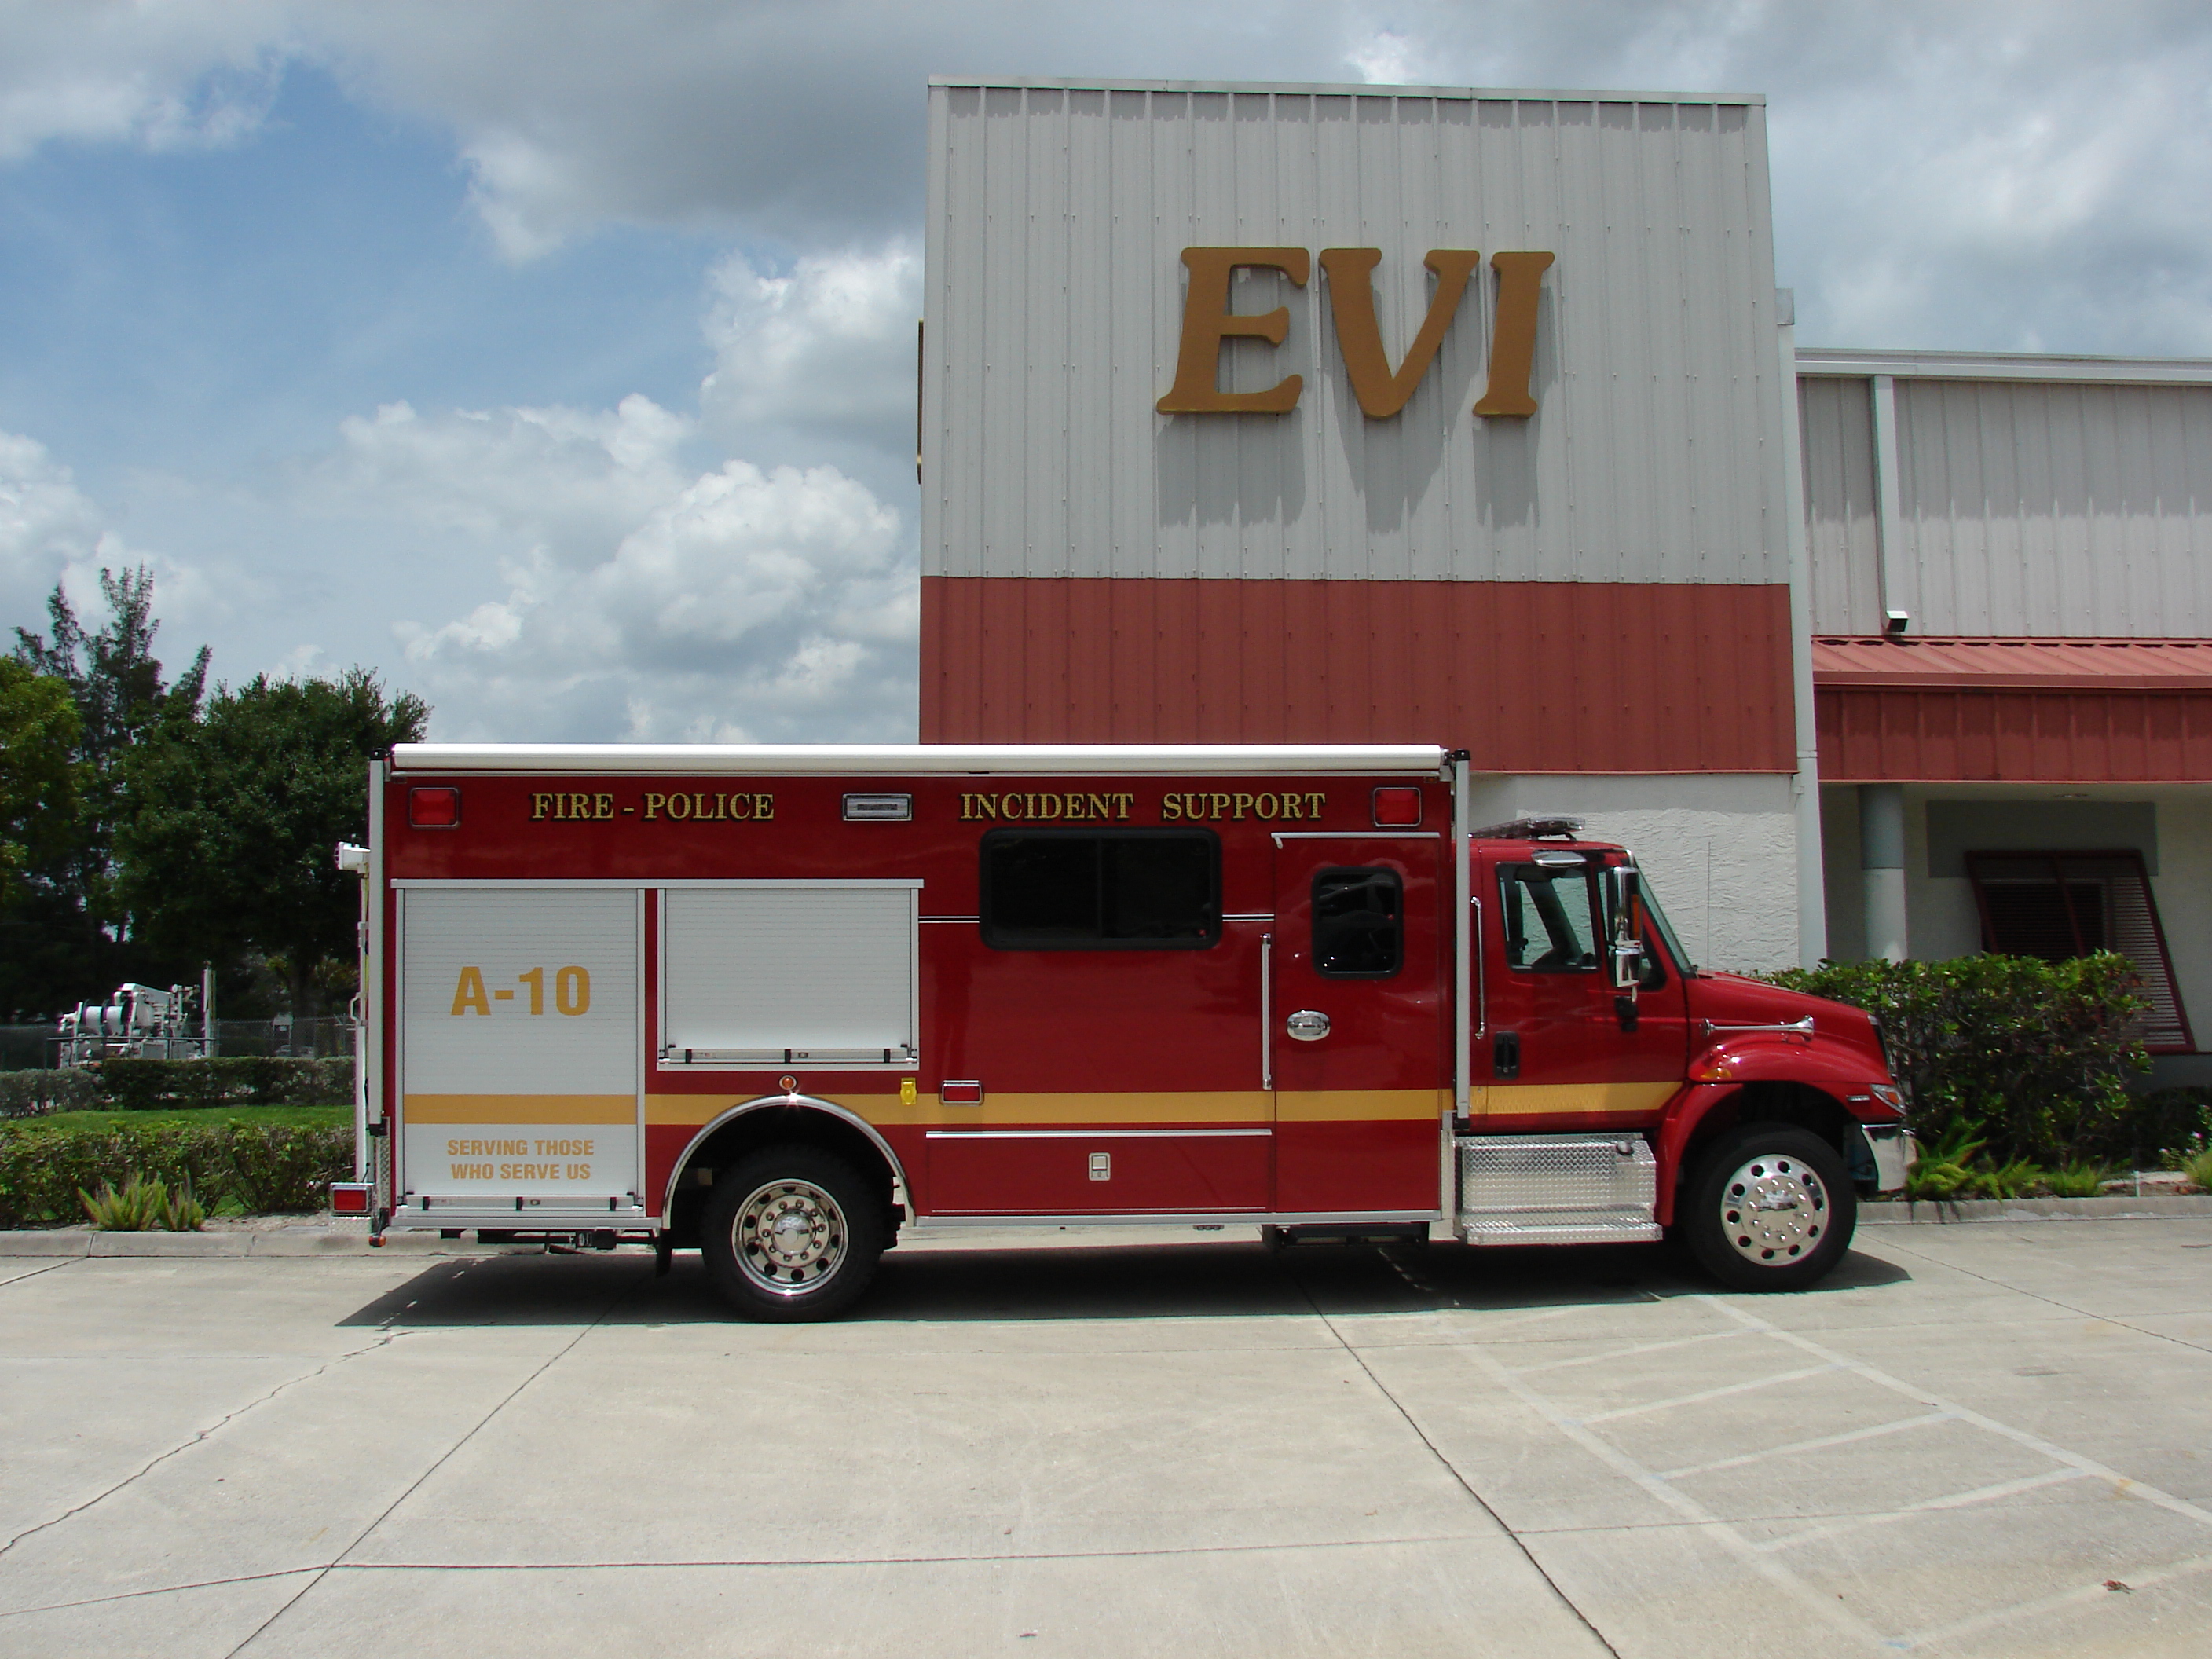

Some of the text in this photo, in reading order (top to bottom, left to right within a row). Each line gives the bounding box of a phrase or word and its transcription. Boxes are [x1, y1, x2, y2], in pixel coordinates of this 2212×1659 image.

[1157, 247, 1555, 419] EVI
[530, 793, 615, 820] FIRE
[643, 793, 775, 820] POLICE
[960, 793, 1326, 819] INCIDENT SUPPORT
[450, 965, 591, 1016] A-10
[447, 1139, 595, 1156] SERVING THOSE
[451, 1163, 591, 1180] WHO SERVE US
